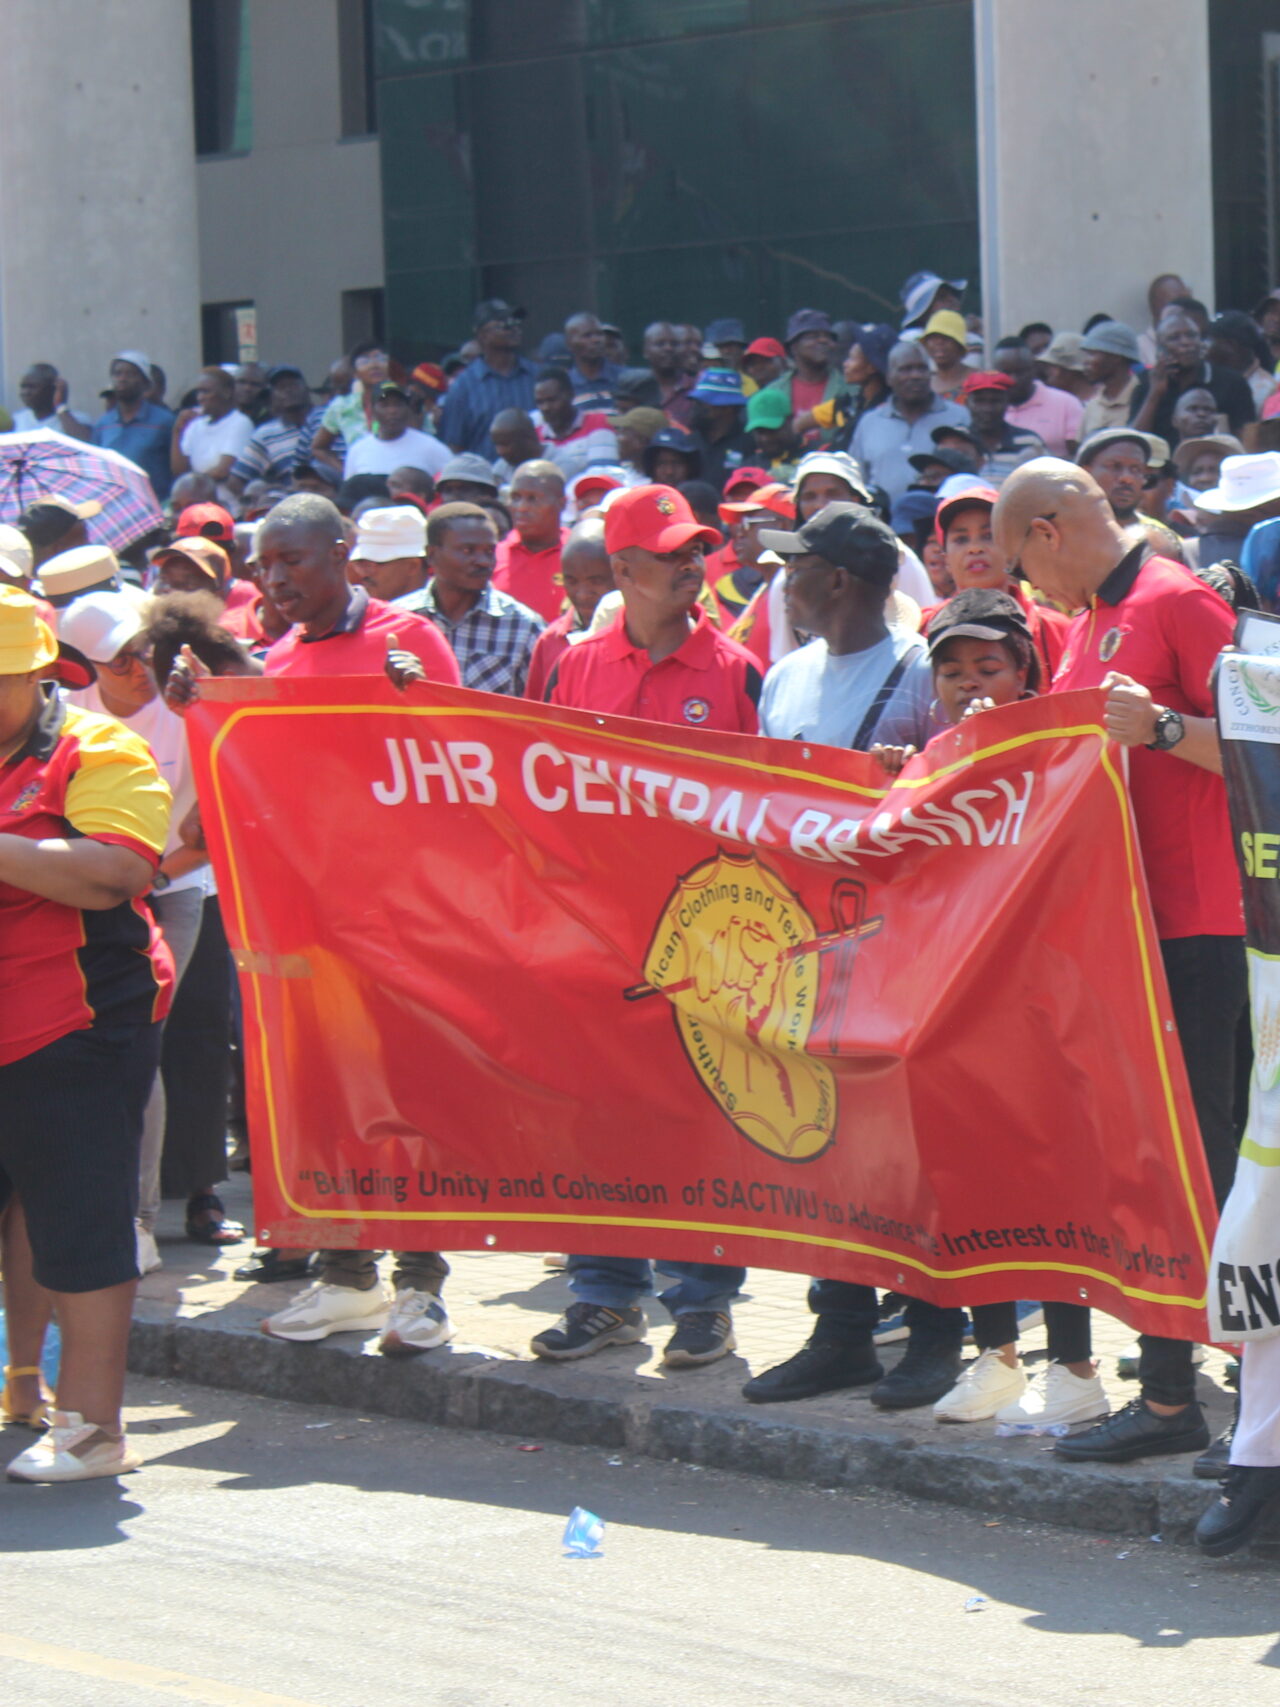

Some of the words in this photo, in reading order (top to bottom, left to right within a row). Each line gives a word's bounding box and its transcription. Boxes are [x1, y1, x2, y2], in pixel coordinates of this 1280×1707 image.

[372, 737, 498, 807] JHB
[789, 770, 1034, 866] BRANCH
[679, 883, 741, 930] Clothing
[744, 886, 775, 913] and
[686, 1013, 738, 1112] Souther
[418, 1169, 490, 1204] Unity
[498, 1172, 546, 1199] and
[552, 1173, 670, 1205] Cohesion
[682, 1178, 705, 1207] of
[711, 1178, 820, 1221] SACTWU
[822, 1199, 845, 1225] to
[942, 1223, 1053, 1257] Interest
[1054, 1222, 1077, 1251] of
[1080, 1224, 1110, 1259] the
